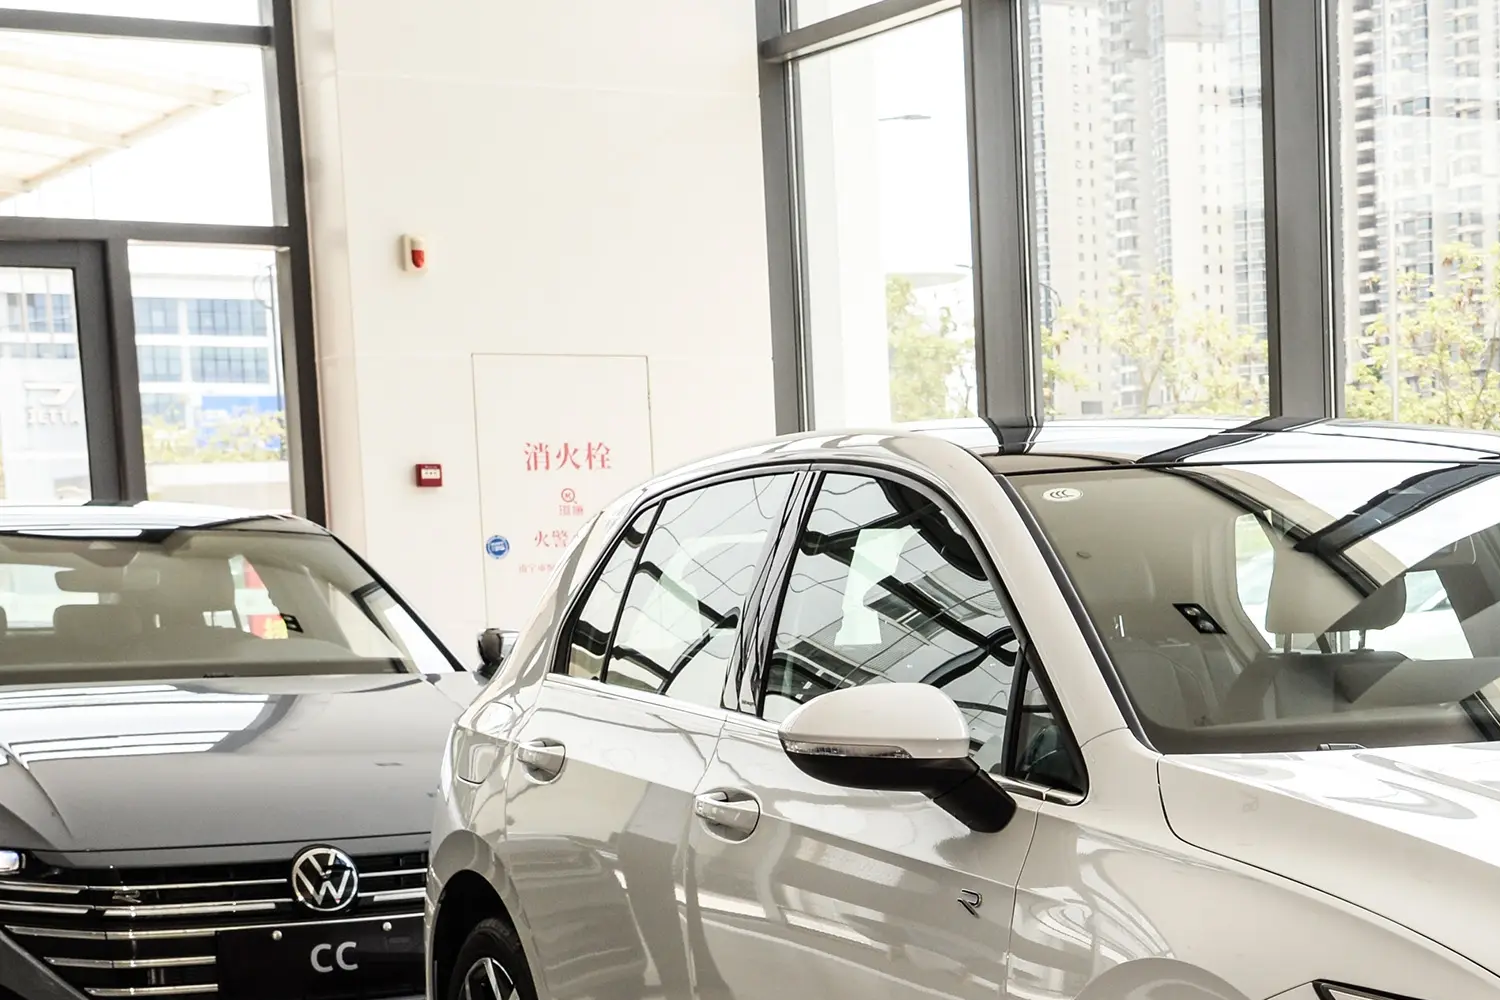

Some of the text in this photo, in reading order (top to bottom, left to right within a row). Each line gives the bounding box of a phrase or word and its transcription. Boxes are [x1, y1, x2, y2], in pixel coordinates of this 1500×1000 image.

[523, 441, 612, 472] 消火栓
[310, 941, 359, 973] CC
